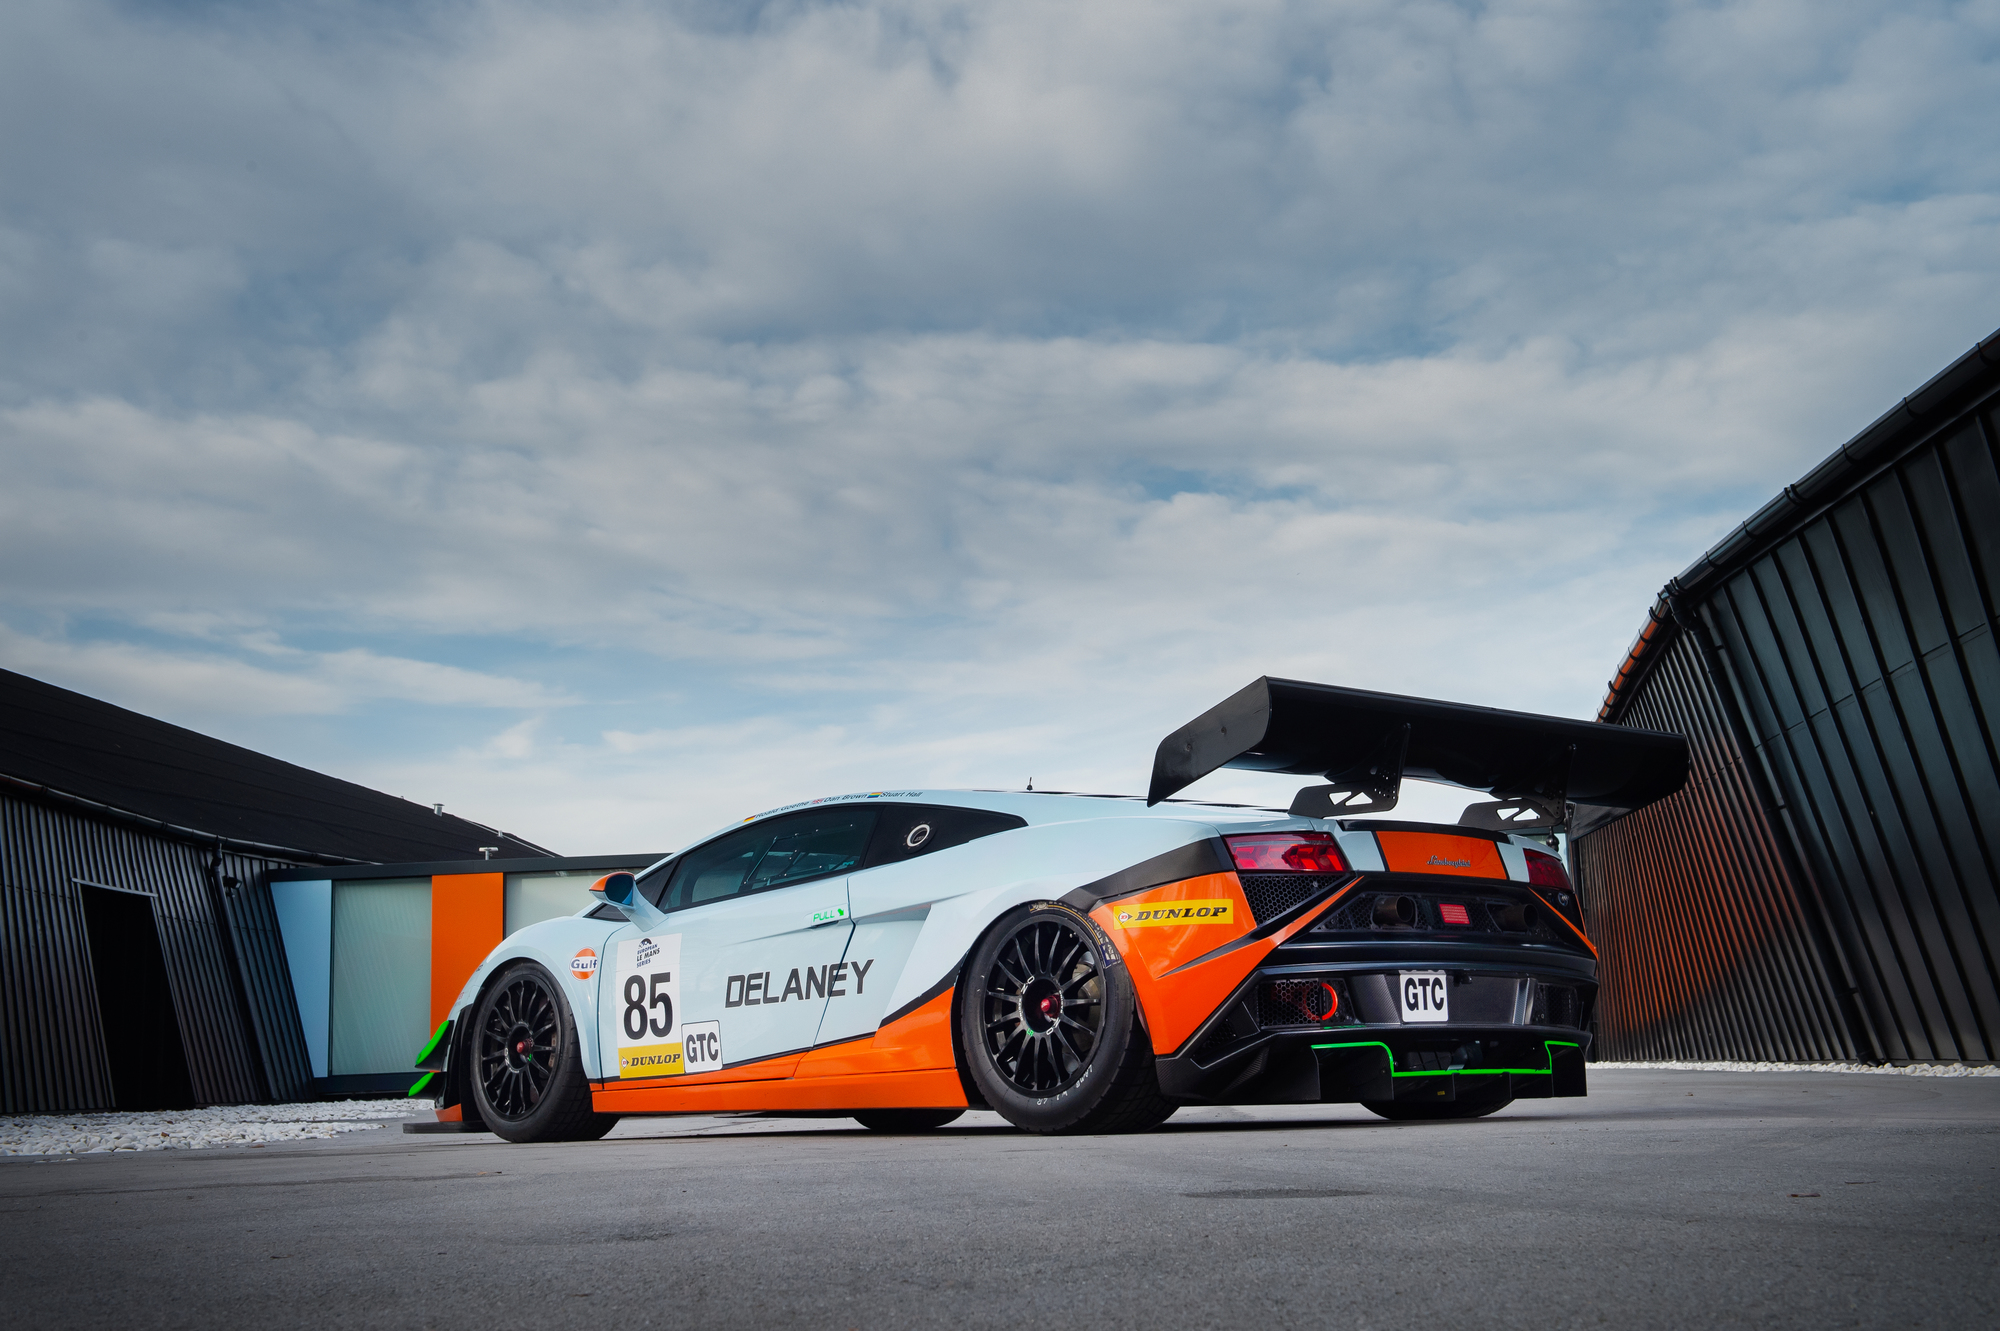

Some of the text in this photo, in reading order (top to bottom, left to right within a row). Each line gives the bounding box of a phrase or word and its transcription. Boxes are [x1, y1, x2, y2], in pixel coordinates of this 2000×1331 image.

[812, 910, 835, 922] PULL
[1135, 906, 1228, 921] DUNLOP
[636, 947, 660, 962] LE MANS
[637, 944, 658, 955] EUROPEAN
[571, 959, 598, 969] Gulf
[636, 958, 651, 968] SERIES
[725, 959, 874, 1008] DELANEY
[1405, 977, 1445, 1011] GTC
[623, 971, 673, 1040] 85
[686, 1031, 719, 1064] GTC
[630, 1053, 681, 1067] DUNLOP
